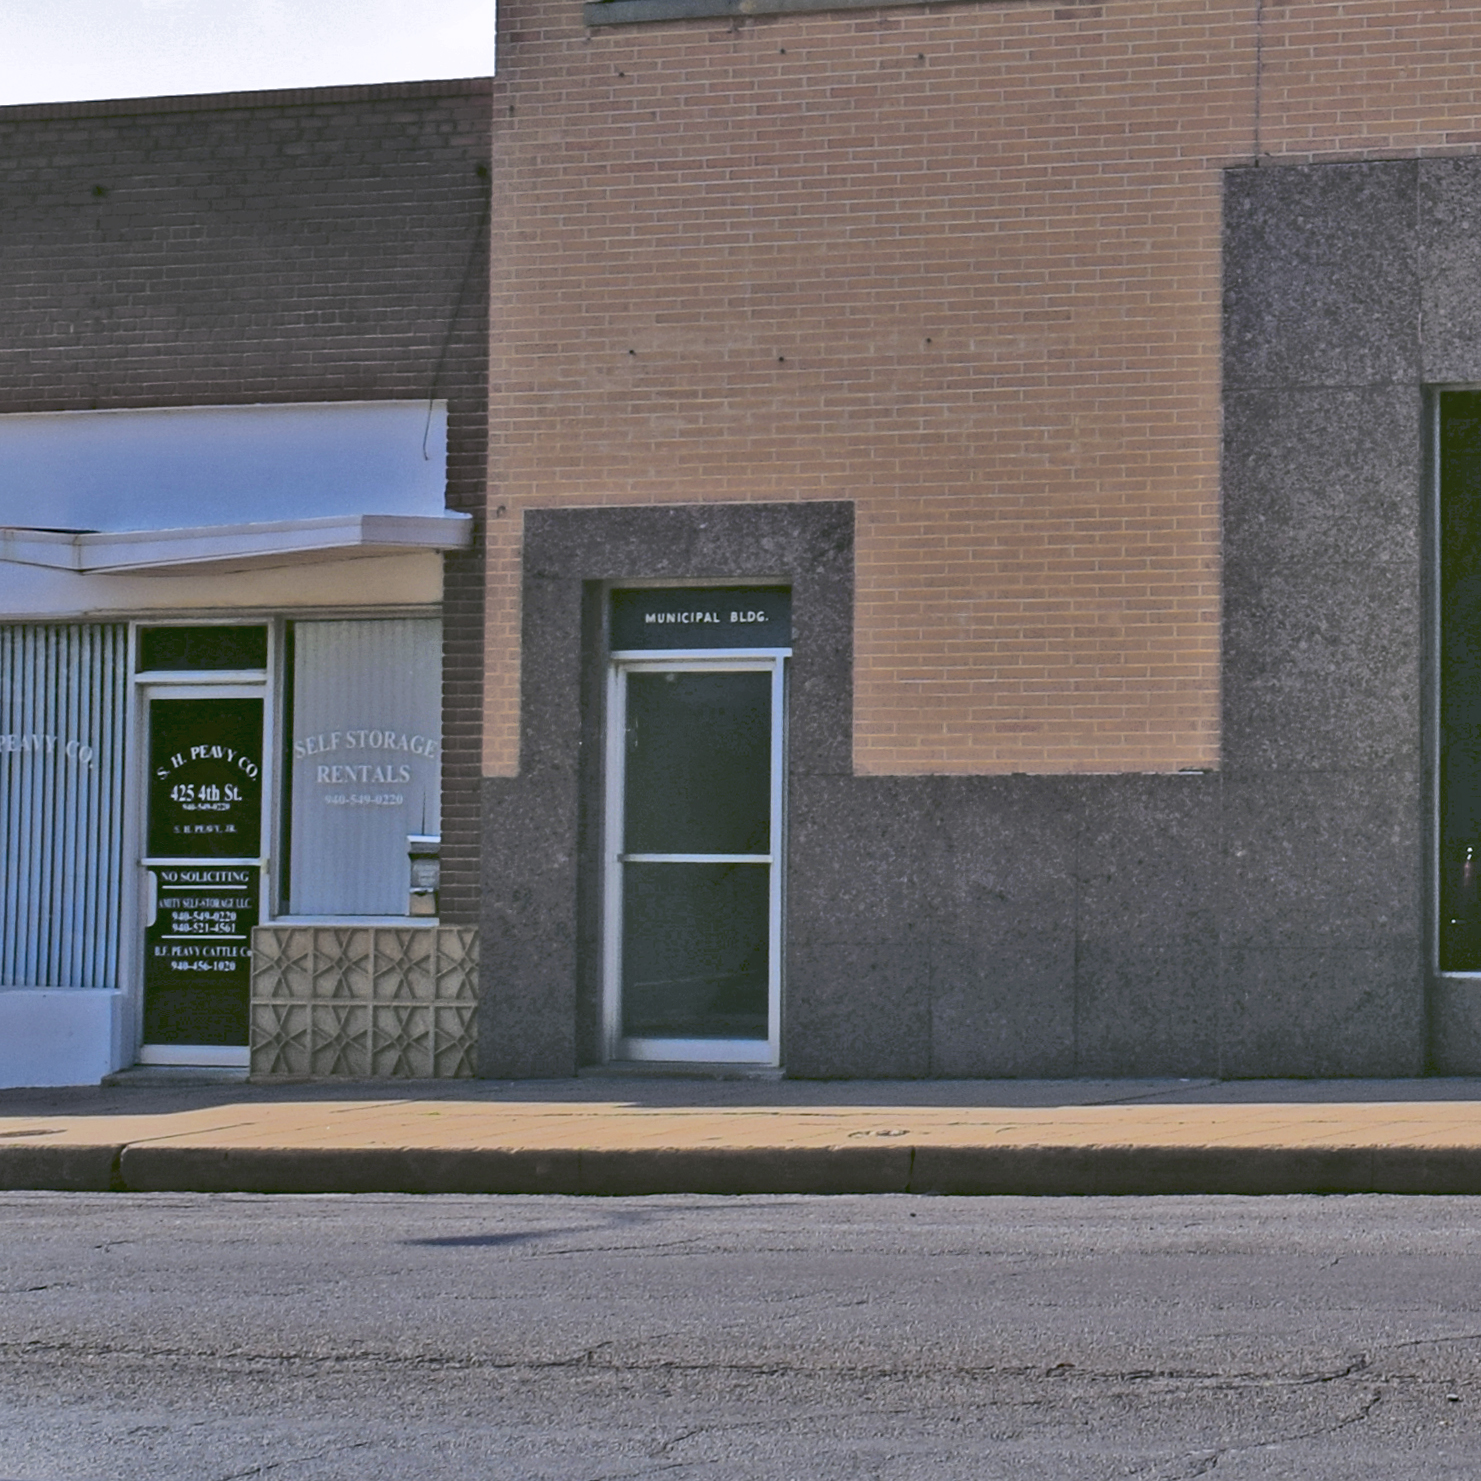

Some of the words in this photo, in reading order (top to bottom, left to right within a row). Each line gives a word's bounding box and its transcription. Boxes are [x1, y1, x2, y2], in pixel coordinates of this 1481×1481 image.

[645, 612, 720, 624] MUNICIPAL
[730, 610, 769, 623] BLDG.
[294, 731, 342, 759] SELF
[346, 729, 438, 758] STORAGE
[66, 739, 94, 769] CO.
[170, 752, 187, 768] H.
[190, 744, 237, 762] PEAVY
[238, 756, 259, 781] CO.
[316, 765, 410, 784] RENTALS
[170, 783, 195, 801] 425
[198, 783, 220, 801] 4th
[224, 783, 243, 801] St.
[325, 794, 403, 805] 940-549-0220
[161, 871, 178, 882] NO
[180, 871, 249, 882] SOLICITING
[171, 911, 237, 921] 940-549-0220
[171, 922, 236, 933] 940-521-4561
[171, 946, 200, 956] PEAVY
[202, 946, 238, 957] CATTLE
[171, 960, 237, 972] 940-456-1020
